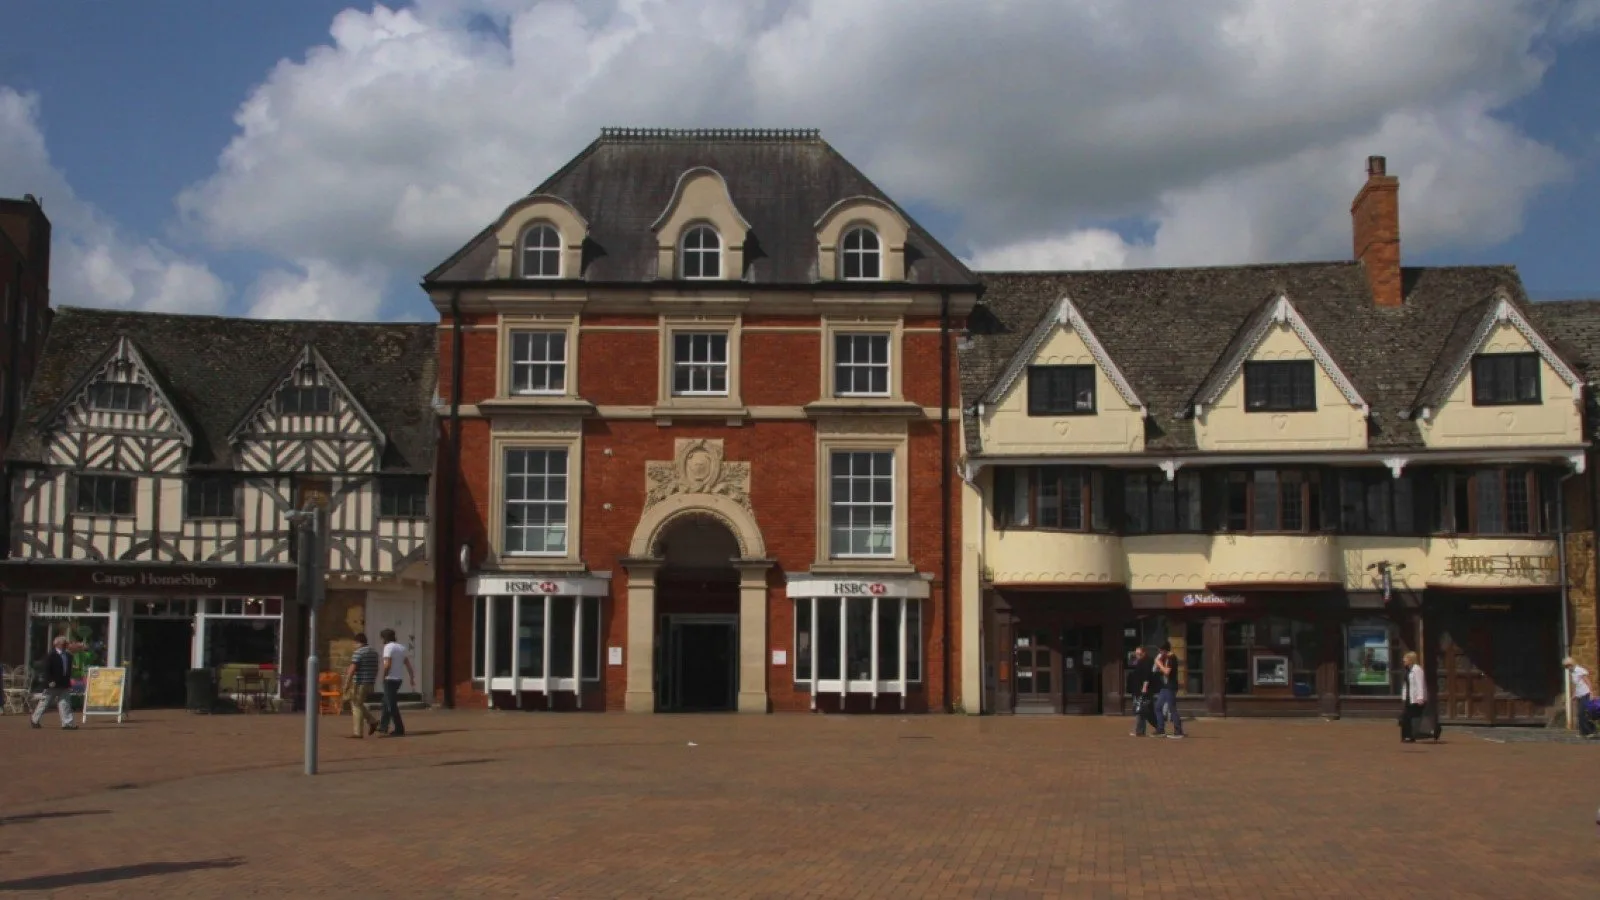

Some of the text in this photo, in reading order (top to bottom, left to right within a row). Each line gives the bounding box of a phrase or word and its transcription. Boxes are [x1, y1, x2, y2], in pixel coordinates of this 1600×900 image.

[92, 572, 217, 588] Cargo HomeShop
[505, 581, 538, 593] HSBC
[834, 583, 868, 594] HSBC
[1194, 594, 1246, 604] Nationwide
